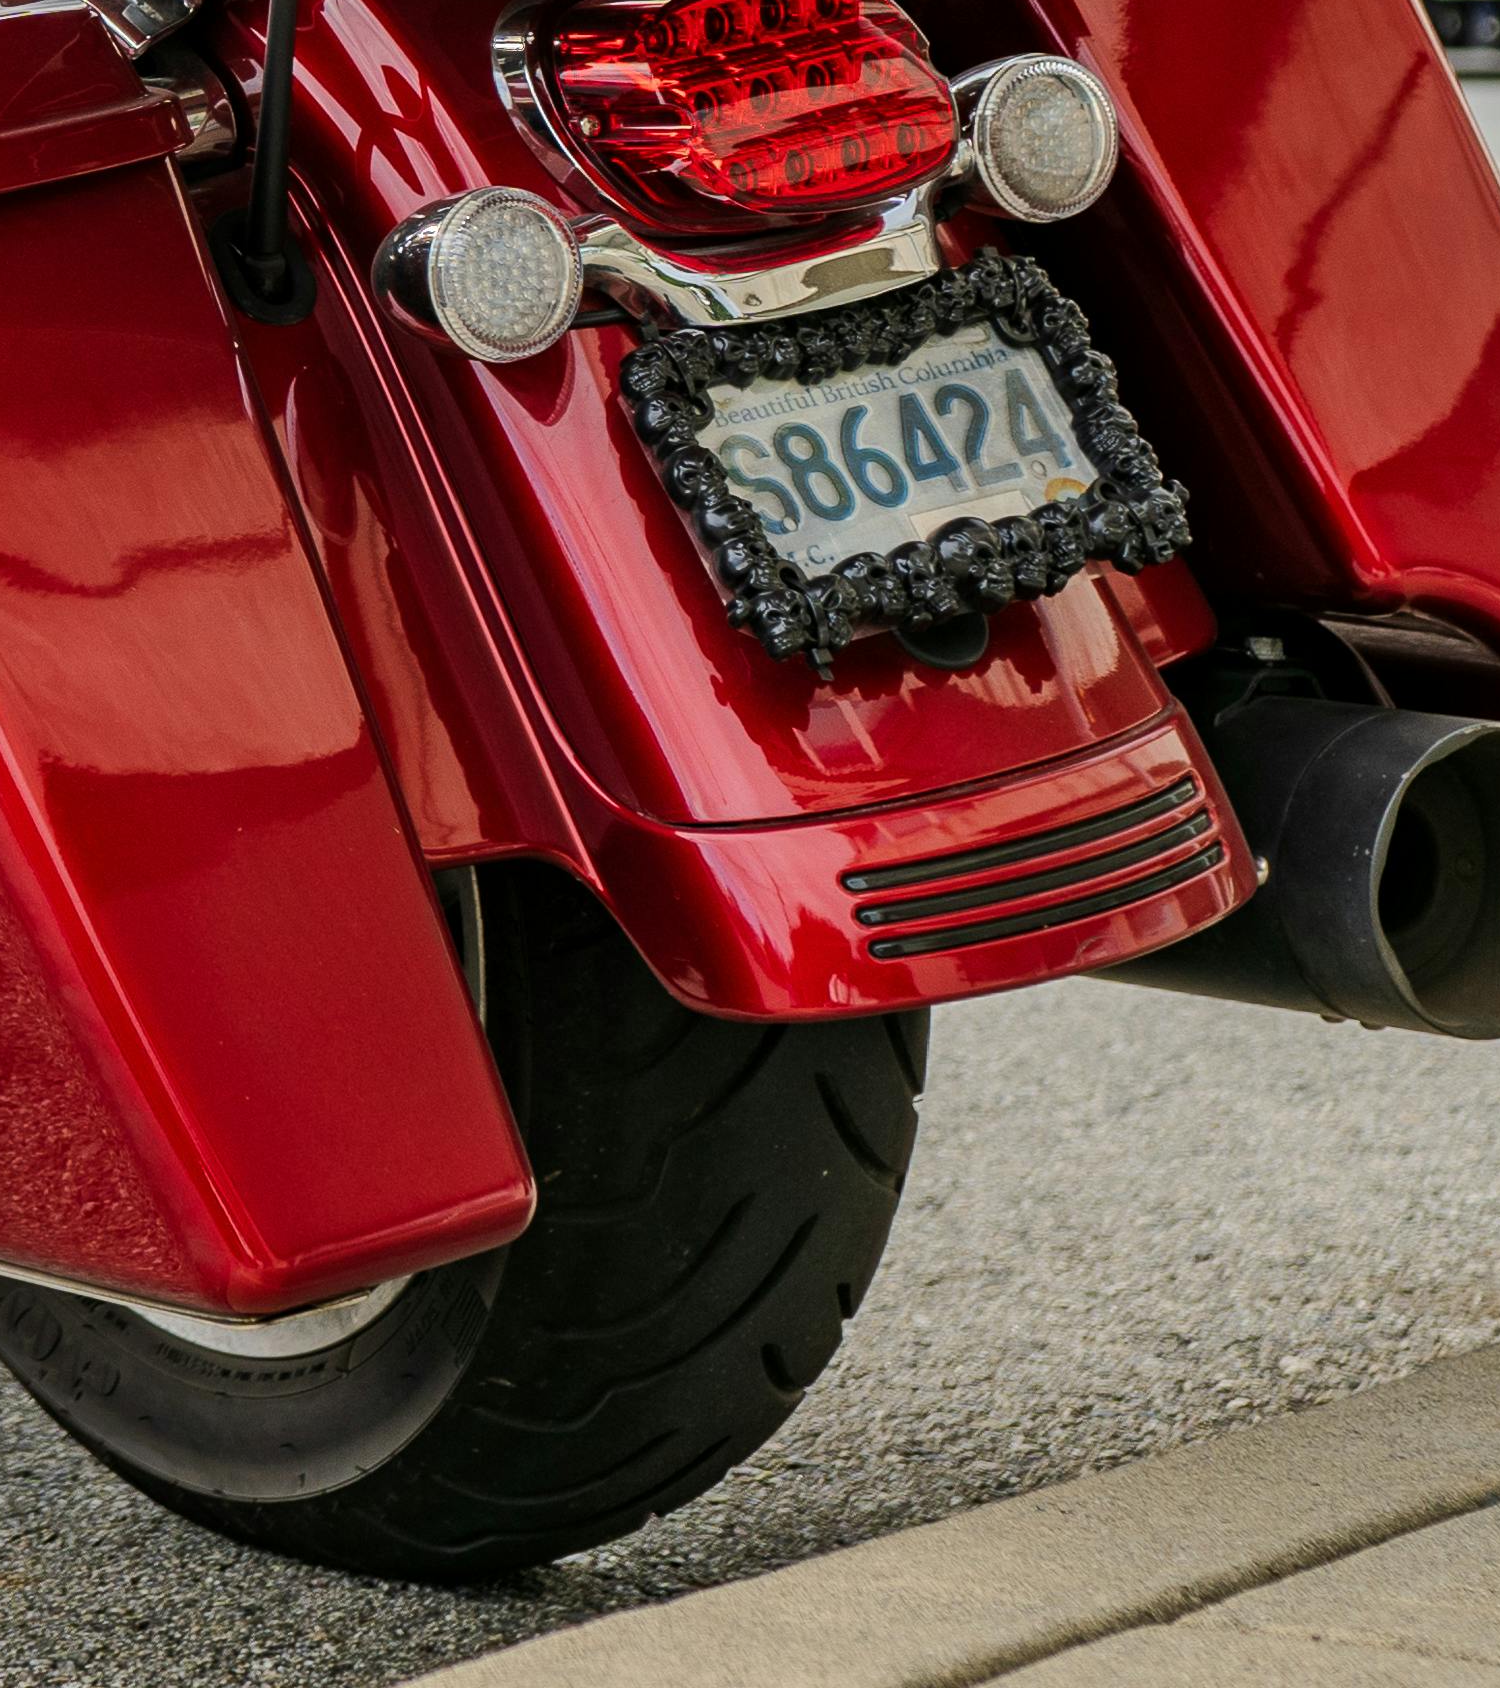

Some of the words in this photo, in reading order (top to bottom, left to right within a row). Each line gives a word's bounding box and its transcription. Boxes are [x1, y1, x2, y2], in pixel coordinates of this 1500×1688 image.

[714, 387, 819, 428] Beautiful
[822, 371, 897, 405] British
[899, 348, 1009, 385] Columbia
[719, 367, 1073, 536] S86424
